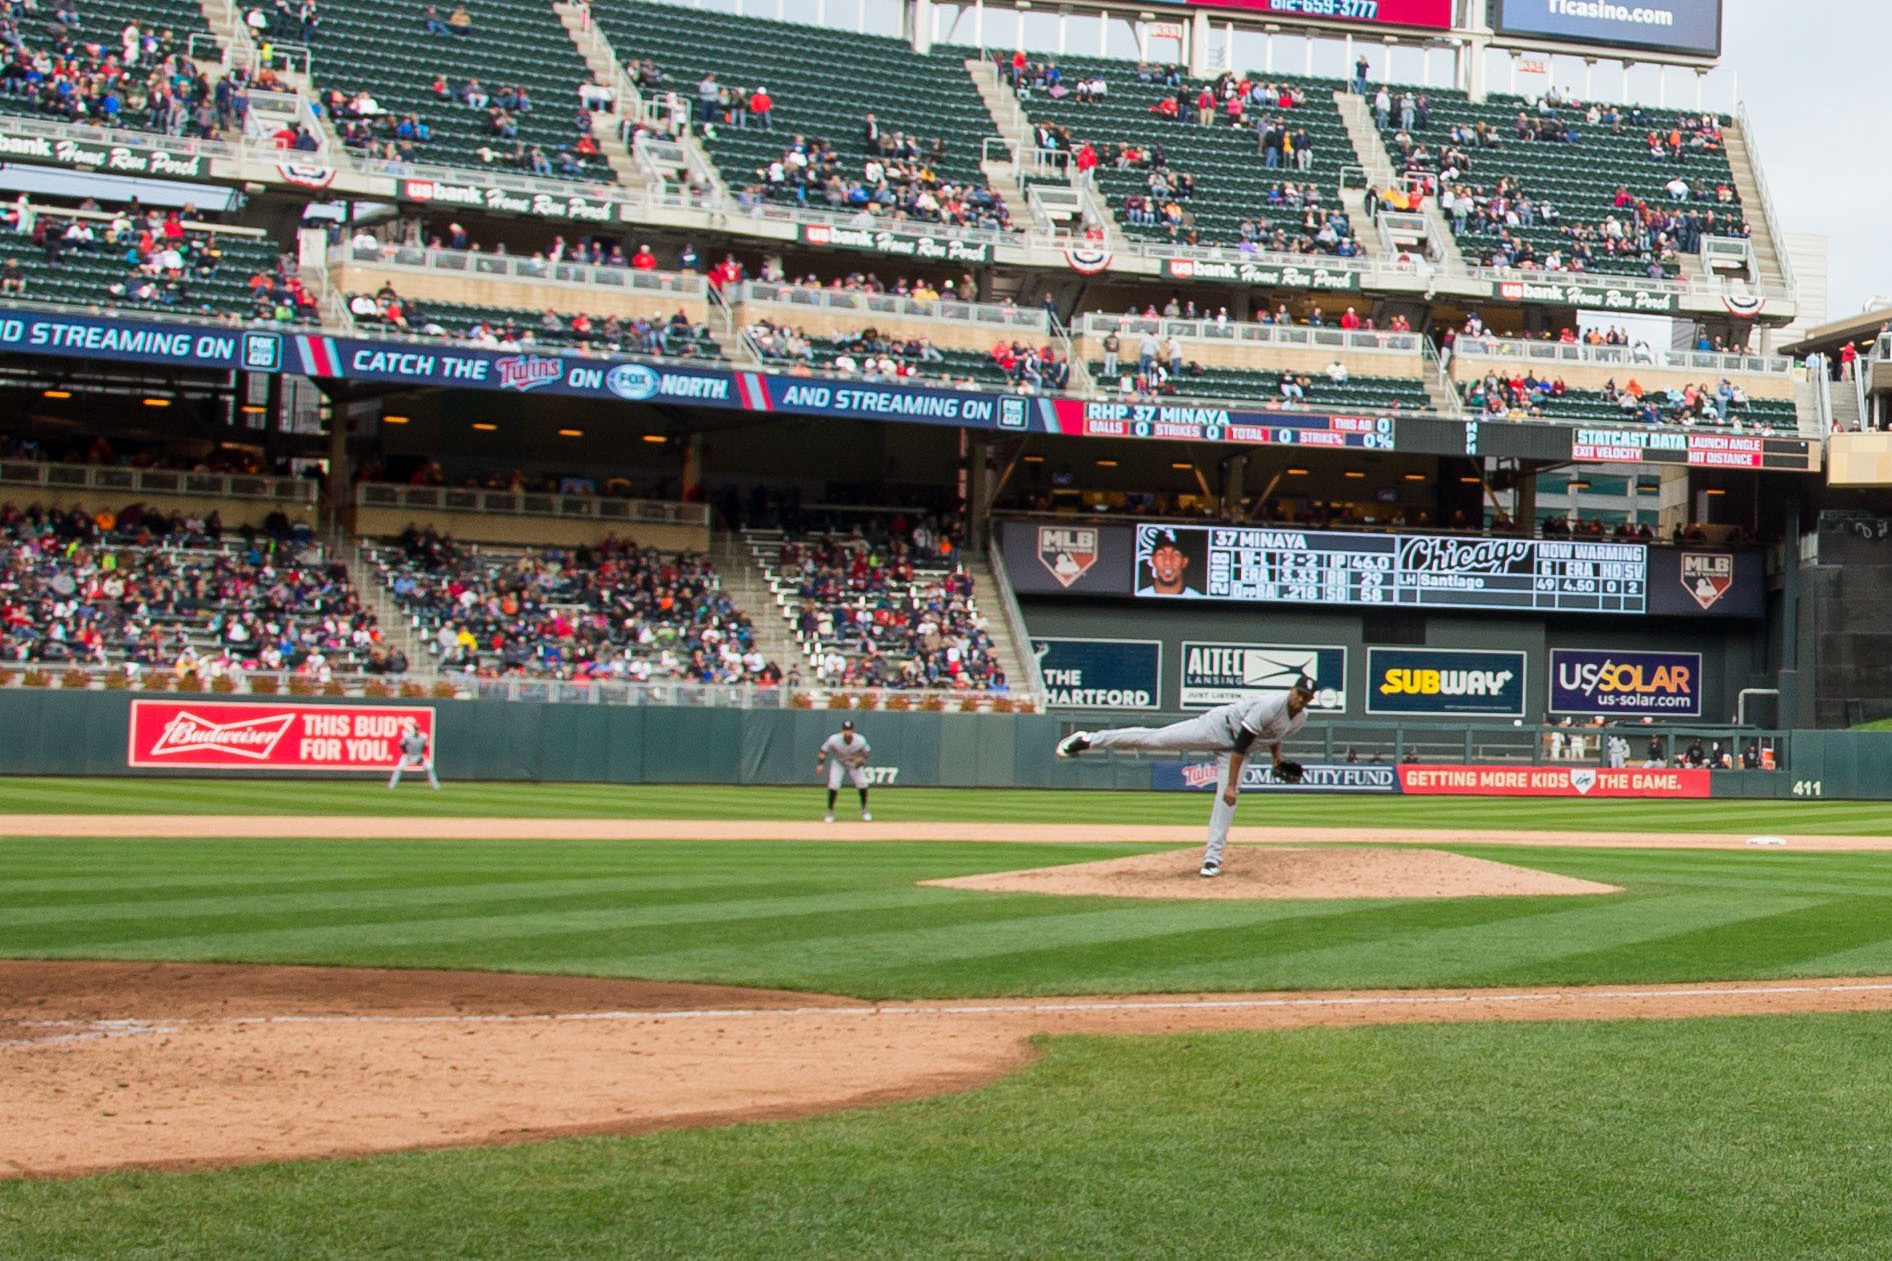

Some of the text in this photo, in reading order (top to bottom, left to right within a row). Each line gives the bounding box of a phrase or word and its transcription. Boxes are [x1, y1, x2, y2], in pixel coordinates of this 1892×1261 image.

[1566, 286, 1602, 305] Home
[1606, 289, 1632, 307] Run
[1634, 291, 1671, 310] Porch
[31, 322, 234, 359] STREAMING ON
[353, 350, 603, 389] CATCH THE Twins ON
[661, 374, 728, 400] NORTH
[783, 386, 993, 421] AND STREAMING ON
[1088, 404, 1229, 426] RHP 37 MINAYA
[1089, 421, 1123, 434] BALLS
[1154, 424, 1200, 439] STRIKES
[1230, 427, 1265, 441] TOTAL
[1577, 430, 1687, 451] STATCAST DATA
[1689, 437, 1761, 452] LAUNCH ANGLE
[1574, 446, 1642, 460] EXIT VELOCITY
[1689, 451, 1753, 465] HIT DISTANCE
[1041, 530, 1095, 547] MLB
[1214, 531, 1307, 550] 37 MINAYA
[1400, 537, 1532, 574] Chicago
[1538, 543, 1642, 562] NOW WARMING
[1352, 555, 1390, 571] 46.0
[1684, 556, 1729, 571] MLB
[1241, 567, 1318, 584] ERA 3.33
[1421, 574, 1484, 589] Santiago
[1563, 579, 1595, 593] 4.50
[1187, 648, 1245, 675] ALTEC
[1043, 669, 1082, 686] THE
[1187, 676, 1243, 686] LANSING
[1379, 668, 1513, 697] SUBWAY
[1044, 690, 1150, 706] HARTFORD
[1598, 693, 1690, 708] us-solar.com
[164, 720, 280, 745] Budweiser
[302, 714, 418, 739] THIS BUD'S
[300, 739, 392, 761] FOR YOU.
[1407, 771, 1682, 791] GETTING MORE KIDS THE GAME.
[1793, 781, 1821, 796] 411
